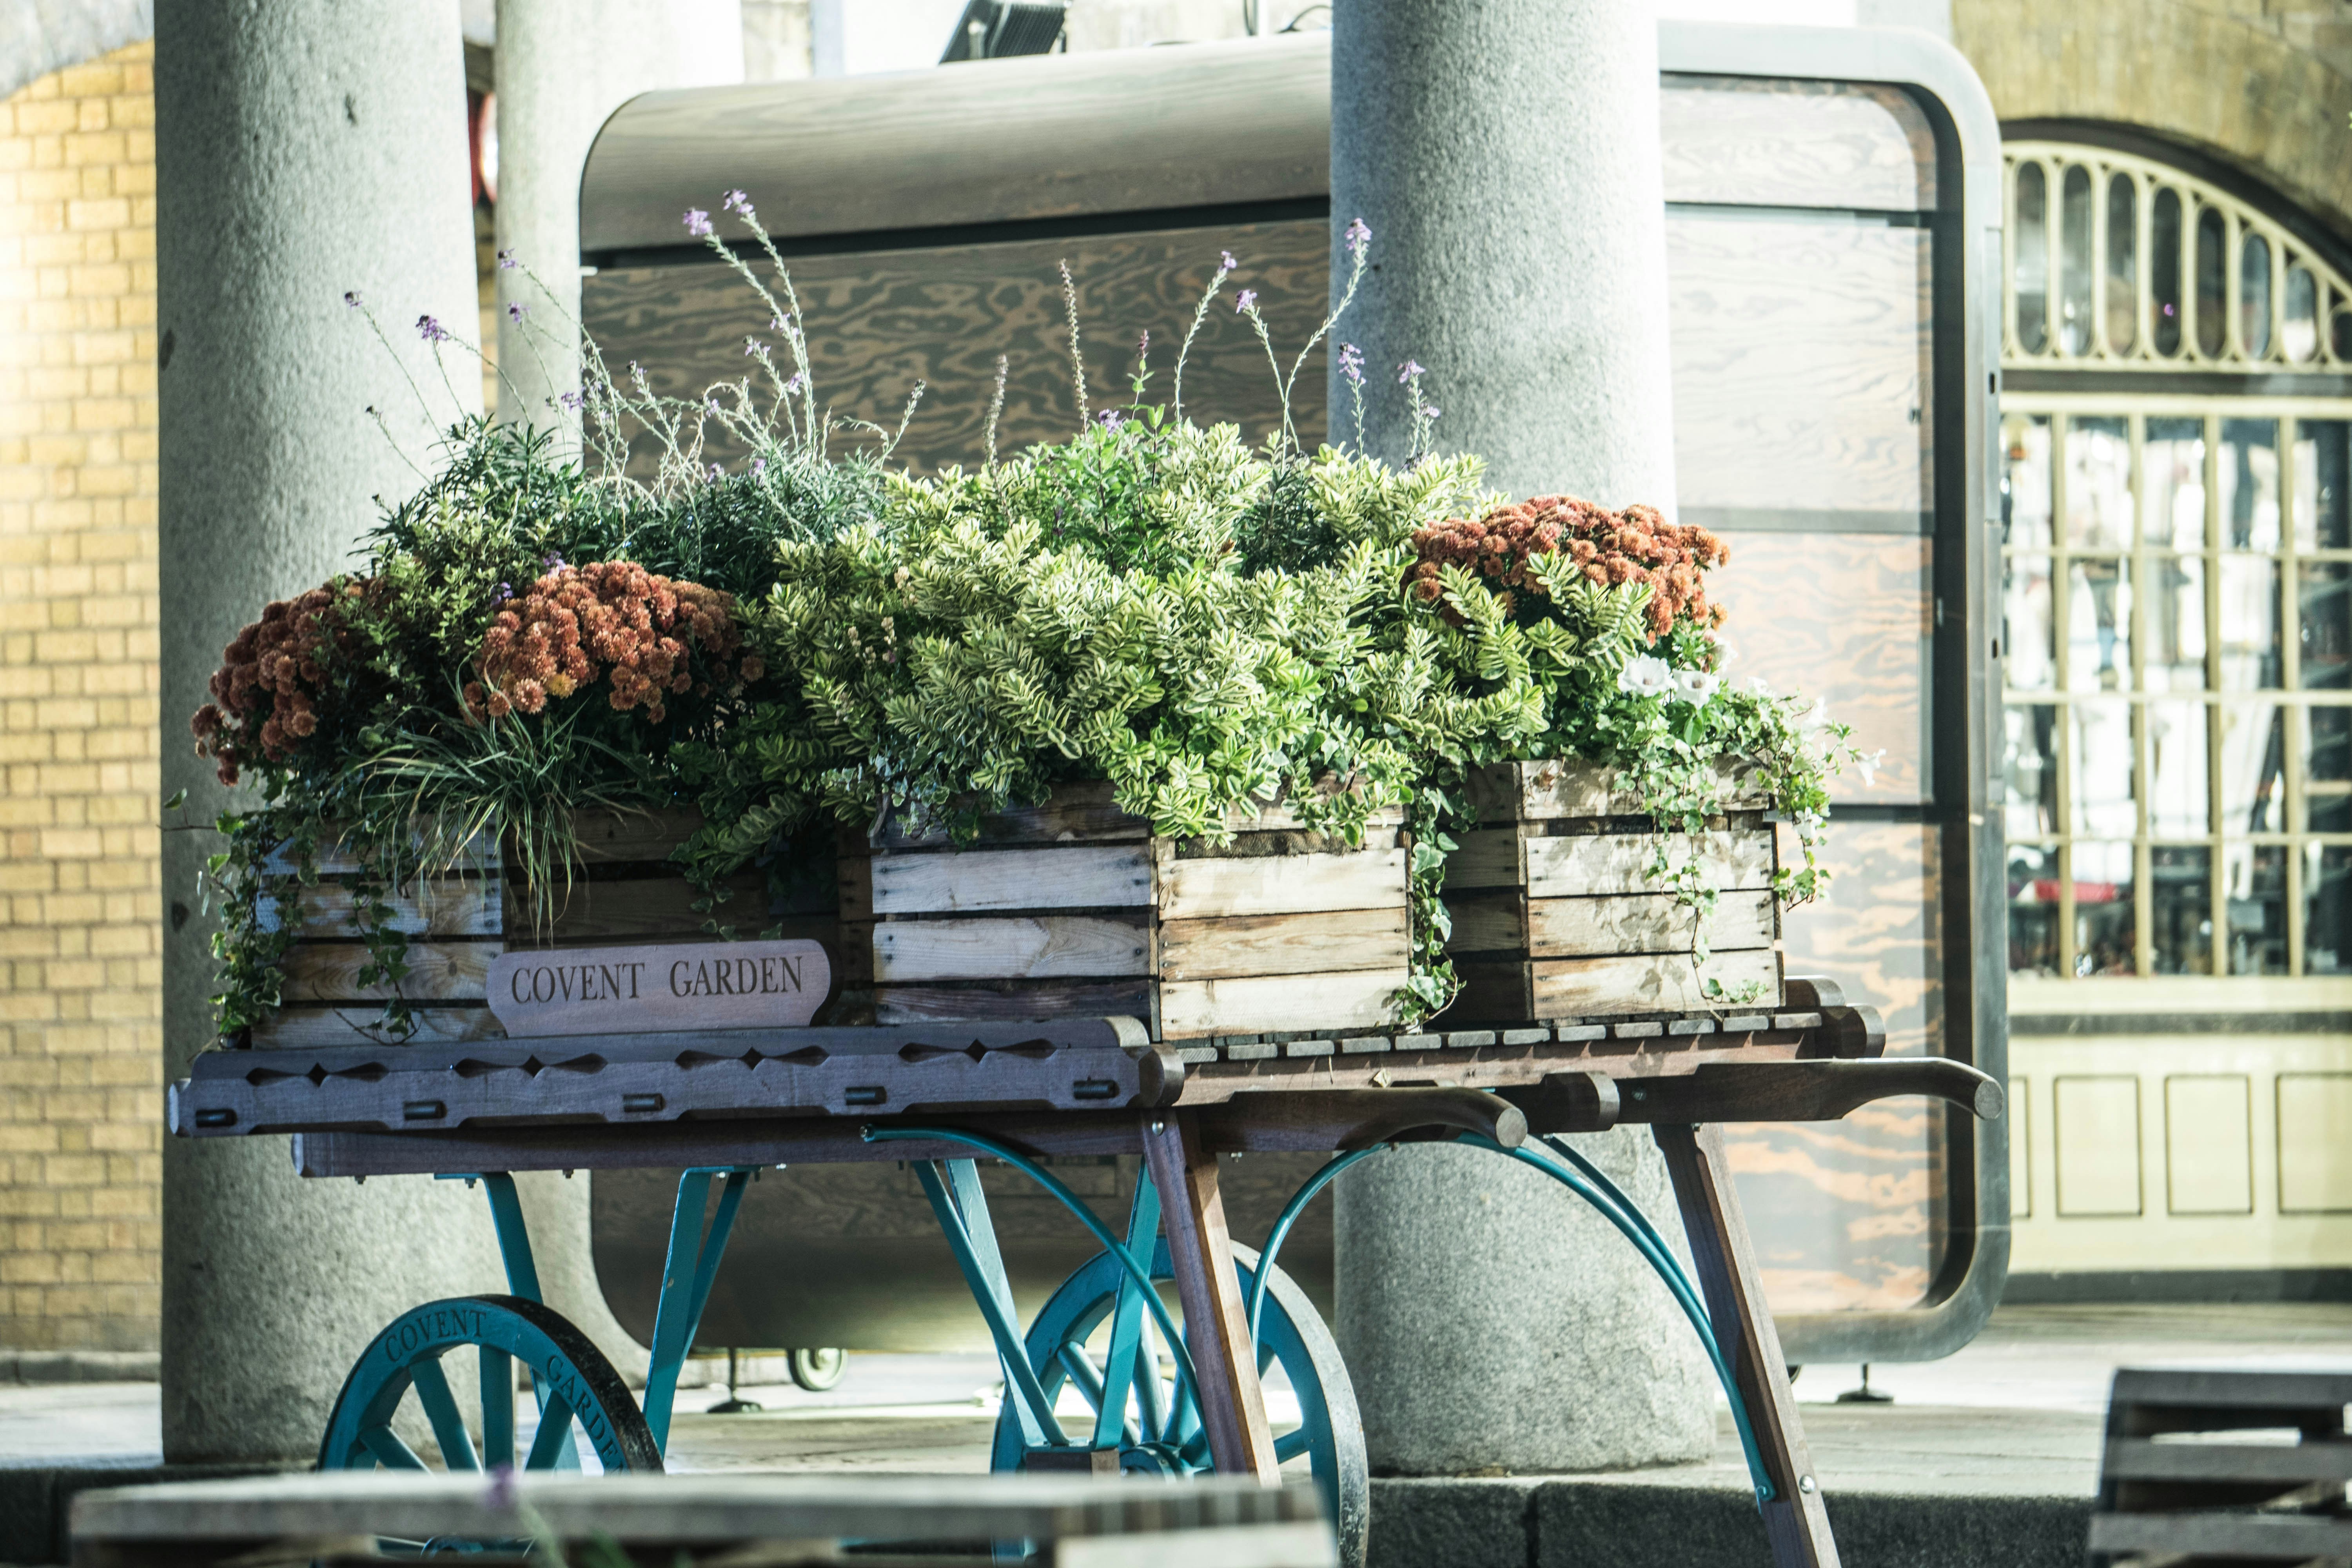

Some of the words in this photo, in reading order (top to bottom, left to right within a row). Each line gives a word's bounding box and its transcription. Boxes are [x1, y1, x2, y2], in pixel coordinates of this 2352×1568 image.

[511, 962, 645, 1005] COVENT
[670, 956, 803, 998] GARDEN
[386, 1309, 486, 1362] COVENT
